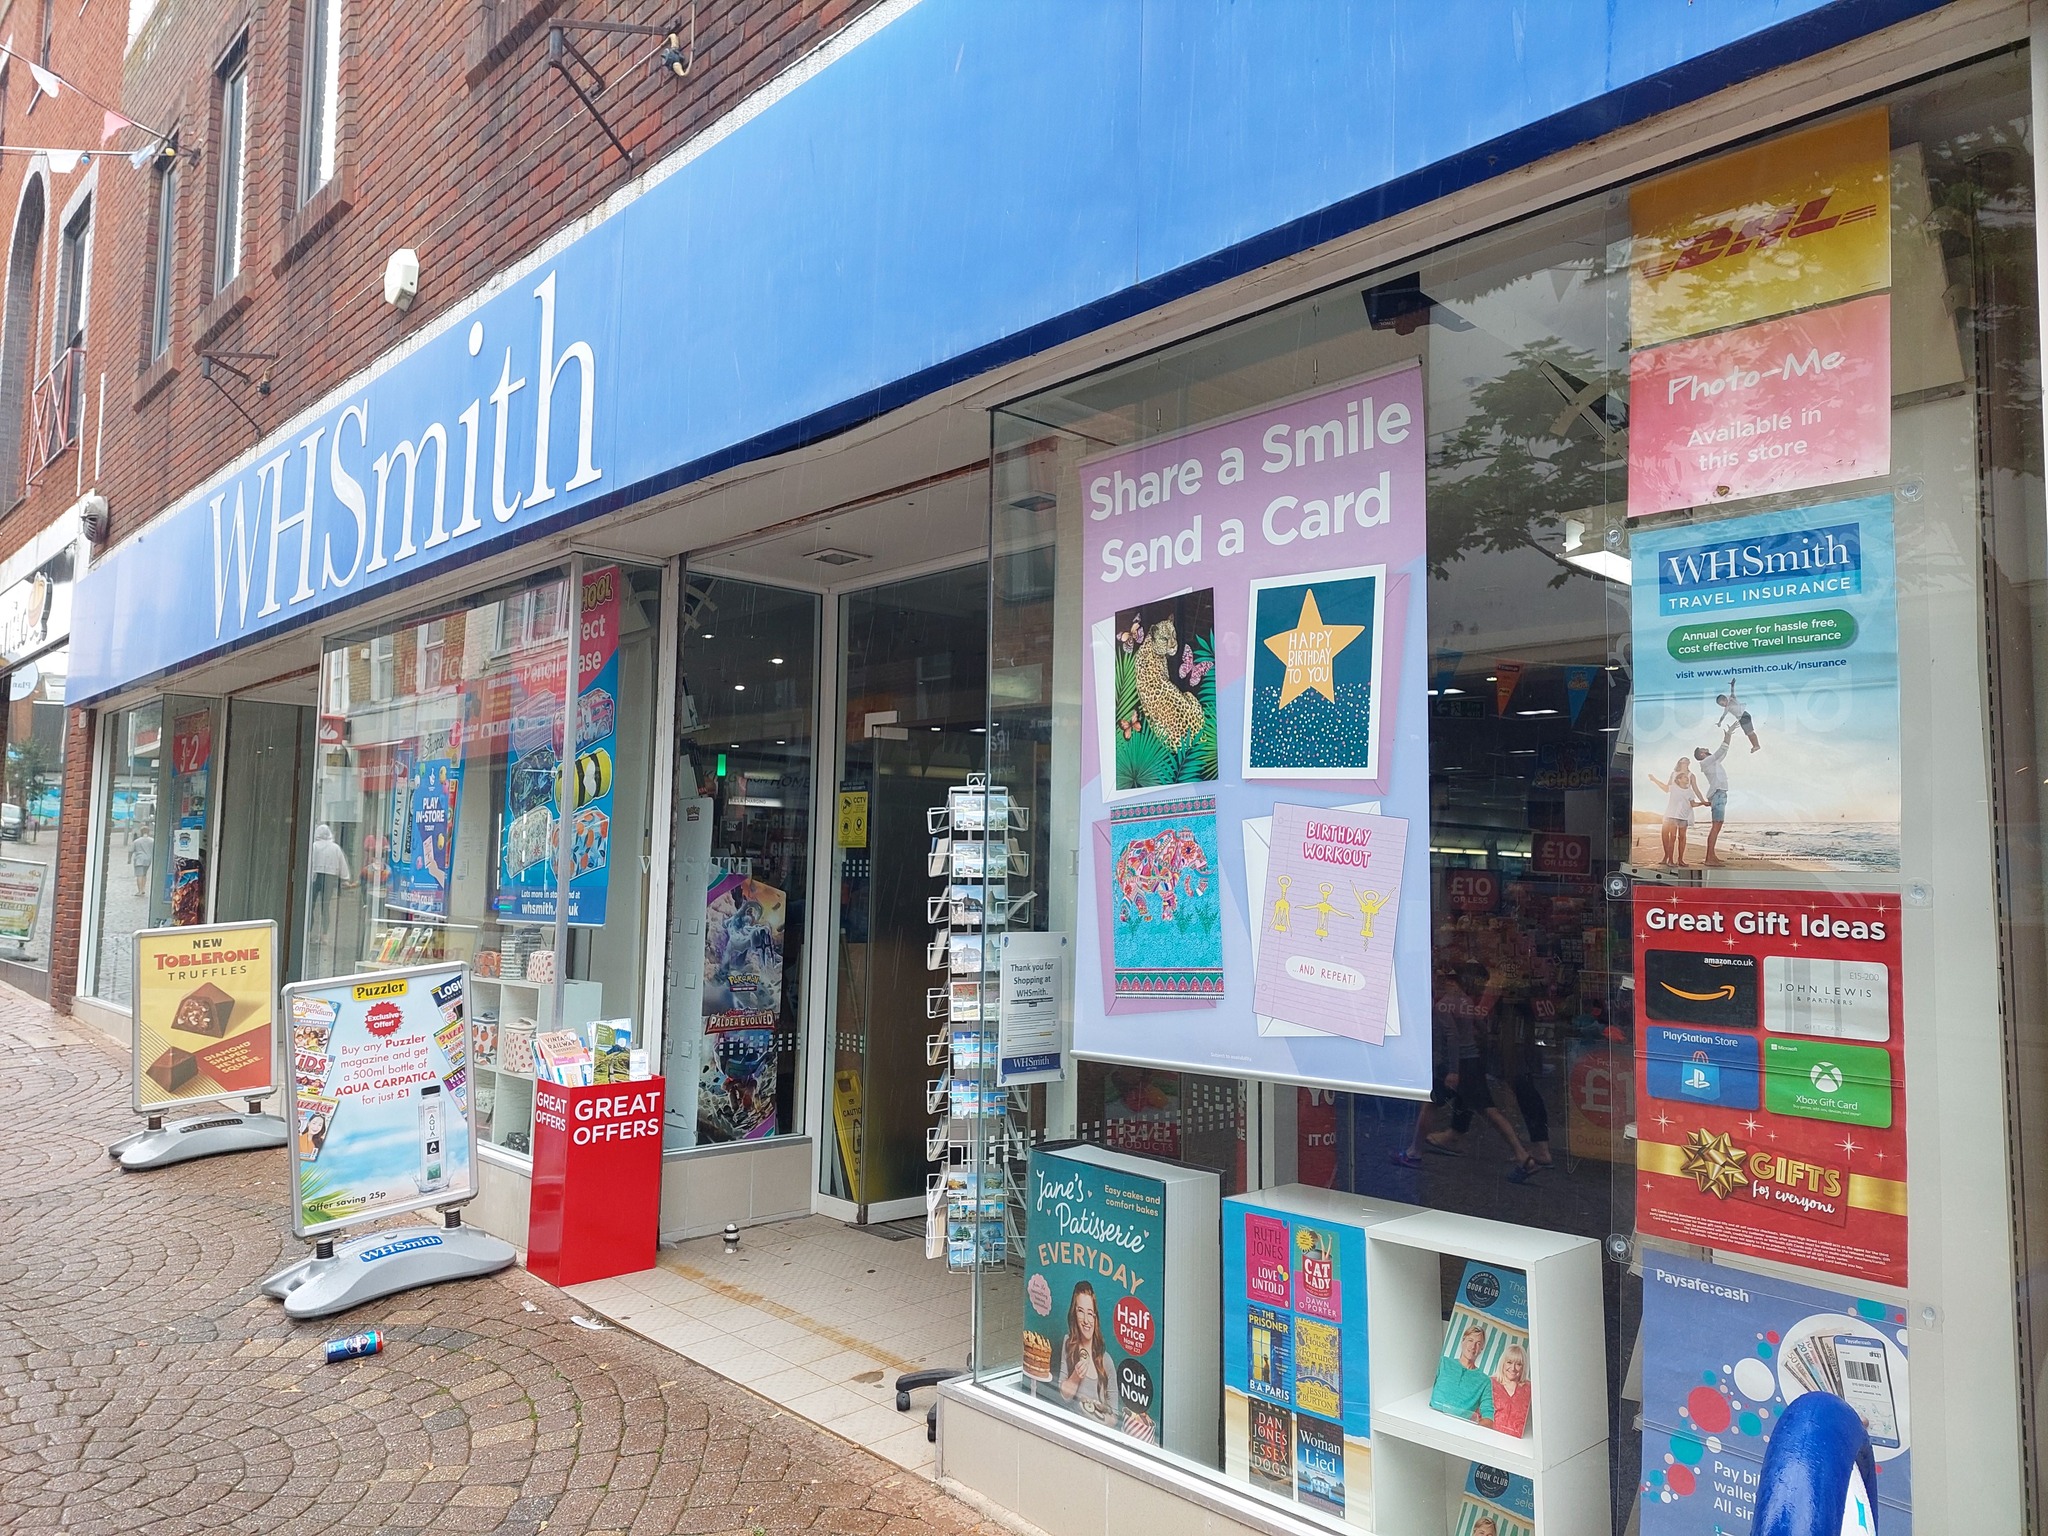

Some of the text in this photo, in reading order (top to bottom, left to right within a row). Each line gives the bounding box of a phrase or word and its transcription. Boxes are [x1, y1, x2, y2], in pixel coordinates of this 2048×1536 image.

[1669, 195, 1844, 273] DHL
[1668, 348, 1846, 405] Photo-Me
[1686, 406, 1822, 450] Available in
[210, 269, 603, 640] WHSmith
[1090, 396, 1412, 521] Share a Smile
[1698, 437, 1808, 472] this store
[1100, 470, 1391, 583] Send a Card
[1668, 534, 1851, 586] WHSmith
[1668, 577, 1851, 610] TRAVEL INSURANCE
[1289, 629, 1333, 650] HAPPY
[1682, 618, 1837, 642] Annual Cover for hassle free,
[1678, 631, 1841, 655] cost effective Travel Insurance
[1288, 647, 1332, 668] BIRTHDAY
[1287, 666, 1330, 685] TO YOU
[1676, 658, 1847, 679] visit www.whsmith.co.uk/insurance
[189, 734, 200, 771] 2
[423, 797, 438, 810] PLAY
[853, 796, 866, 804] CCTV
[416, 810, 445, 823] IN-STORE
[1306, 820, 1372, 847] BIRTHDAY
[1303, 842, 1372, 869] WORKOUT
[1541, 840, 1582, 859] £10
[1558, 859, 1578, 868] LESS
[531, 891, 543, 899] more
[1451, 877, 1492, 896] £10
[1453, 895, 1488, 904] OR LESS
[1646, 907, 1886, 940] Great Gift Ideas
[193, 938, 222, 949] NEW
[154, 948, 260, 970] TOBLERONE
[1011, 962, 1054, 972] Thank you for
[1703, 957, 1753, 967] amazon.co.uk
[168, 965, 247, 981] TRUFFLES
[1013, 976, 1044, 985] Shopping
[1292, 963, 1356, 985] ...AND REPEAT!
[356, 981, 405, 999] Puzzler
[1016, 989, 1048, 997] WHSmith.
[1779, 982, 1872, 998] JOHN LEWIS
[1438, 1002, 1489, 1016] OR LESS
[1536, 1000, 1556, 1018] £10
[1806, 997, 1853, 1006] PARTNERS
[367, 1012, 400, 1022] Exclusive
[373, 1020, 394, 1029] Offer!
[709, 1014, 774, 1029] PALDEA EVOLVED
[341, 1034, 426, 1057] Buy any Puzzler
[548, 1039, 576, 1050] RAILWAY
[1663, 1030, 1738, 1047] PlayStation Store
[203, 1041, 251, 1061] DIAMOND
[340, 1047, 428, 1069] magazine and get
[216, 1055, 249, 1070] NEVER
[221, 1056, 264, 1074] SQUARE.
[344, 1058, 427, 1082] a 500ml bottle of
[1013, 1056, 1050, 1068] WHSmith
[335, 1071, 437, 1097] AQUA CARPATICA
[361, 1088, 410, 1105] for just £1
[537, 1092, 567, 1115] GREAT
[574, 1091, 661, 1121] GREAT
[1796, 1095, 1818, 1105] Xbox
[1820, 1098, 1835, 1107] Gift
[1837, 1100, 1858, 1110] Card
[536, 1110, 566, 1133] OFFERS
[573, 1118, 660, 1146] OFFERS
[1110, 1122, 1173, 1143] TRAVEL
[1308, 1134, 1319, 1147] IT
[1749, 1152, 1842, 1198] GIFTS
[1036, 1169, 1084, 1211] Jane's
[1104, 1185, 1161, 1205] Easy cakes and
[1752, 1180, 1835, 1215] for everyone
[308, 1202, 333, 1212] Offer
[336, 1195, 366, 1208] saving
[369, 1190, 387, 1202] 25p
[1105, 1198, 1159, 1216] comfort bakes
[1055, 1202, 1145, 1253] Patisserie
[1254, 1226, 1281, 1245] RUTH
[361, 1236, 441, 1261] WHSmith
[1252, 1241, 1284, 1261] JONES
[1038, 1241, 1145, 1295] EVERYDAY
[1258, 1266, 1278, 1282] LOVE
[1304, 1259, 1331, 1278] CAT
[1252, 1278, 1284, 1296] UNTOLD
[1305, 1275, 1331, 1290] LADY
[1467, 1282, 1499, 1298] BOOK CLUB
[1509, 1280, 1526, 1293] The
[1656, 1268, 1749, 1303] Paysafe:cash
[1299, 1301, 1337, 1317] O'PORTER
[1305, 1297, 1330, 1308] DAWN
[1117, 1304, 1150, 1330] Half
[1262, 1309, 1275, 1320] THE
[1120, 1324, 1145, 1342] Price
[1248, 1315, 1289, 1334] PRISONER
[1306, 1336, 1329, 1350] House
[1302, 1347, 1333, 1362] Fortune
[1122, 1367, 1146, 1389] Out
[1120, 1383, 1149, 1407] Now
[1265, 1385, 1290, 1401] PARIS
[1302, 1394, 1333, 1410] BURTON
[1308, 1387, 1329, 1399] JESSIE
[1258, 1412, 1283, 1429] DAN
[1253, 1424, 1288, 1446] JONES
[1300, 1429, 1342, 1456] Woman
[1253, 1441, 1288, 1465] ESSEX
[1305, 1449, 1336, 1474] Lied
[1254, 1455, 1287, 1477] DOGS
[1714, 1461, 1739, 1483] Pay
[1476, 1470, 1508, 1487] BOOK CLUB
[1713, 1497, 1732, 1514] All
